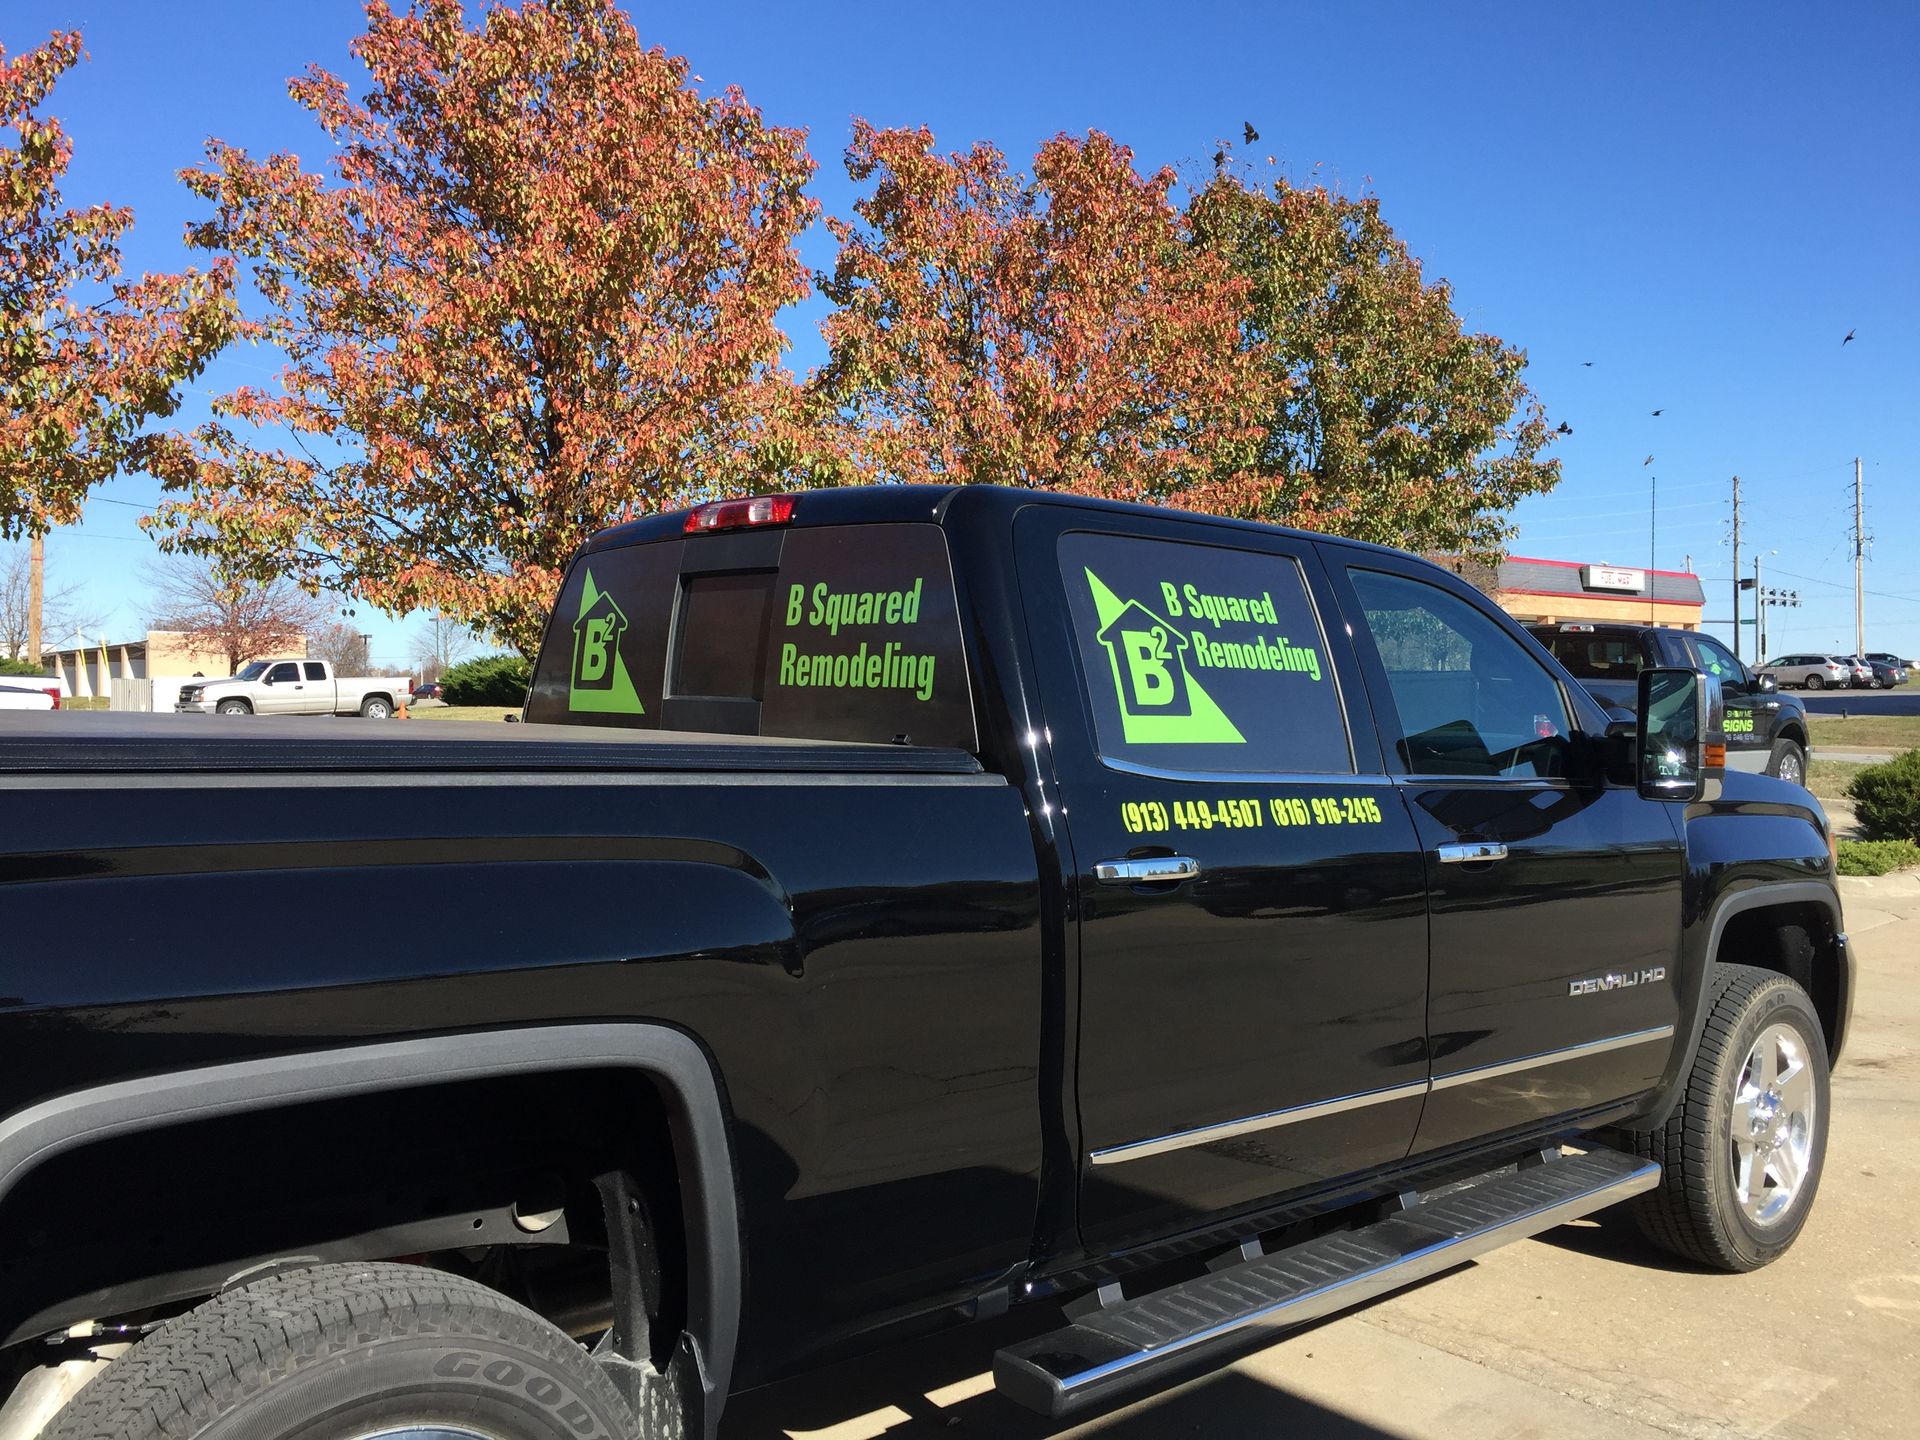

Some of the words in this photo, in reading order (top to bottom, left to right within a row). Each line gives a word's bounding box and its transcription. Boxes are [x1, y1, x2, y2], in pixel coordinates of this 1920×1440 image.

[785, 583, 805, 627] B
[808, 577, 923, 636] Squared
[1160, 581, 1183, 618] B
[1183, 583, 1279, 629] Squared
[779, 642, 936, 701] Remodeling
[1190, 630, 1322, 682] Remodeling
[1722, 719, 1754, 732] SIGNS
[1121, 802, 1170, 833] (913)
[1173, 799, 1263, 831] 449-4507
[1269, 798, 1311, 827] (816)
[1312, 797, 1382, 825] 916-2415
[1568, 971, 1638, 997] DENALI
[1640, 967, 1666, 984] HD
